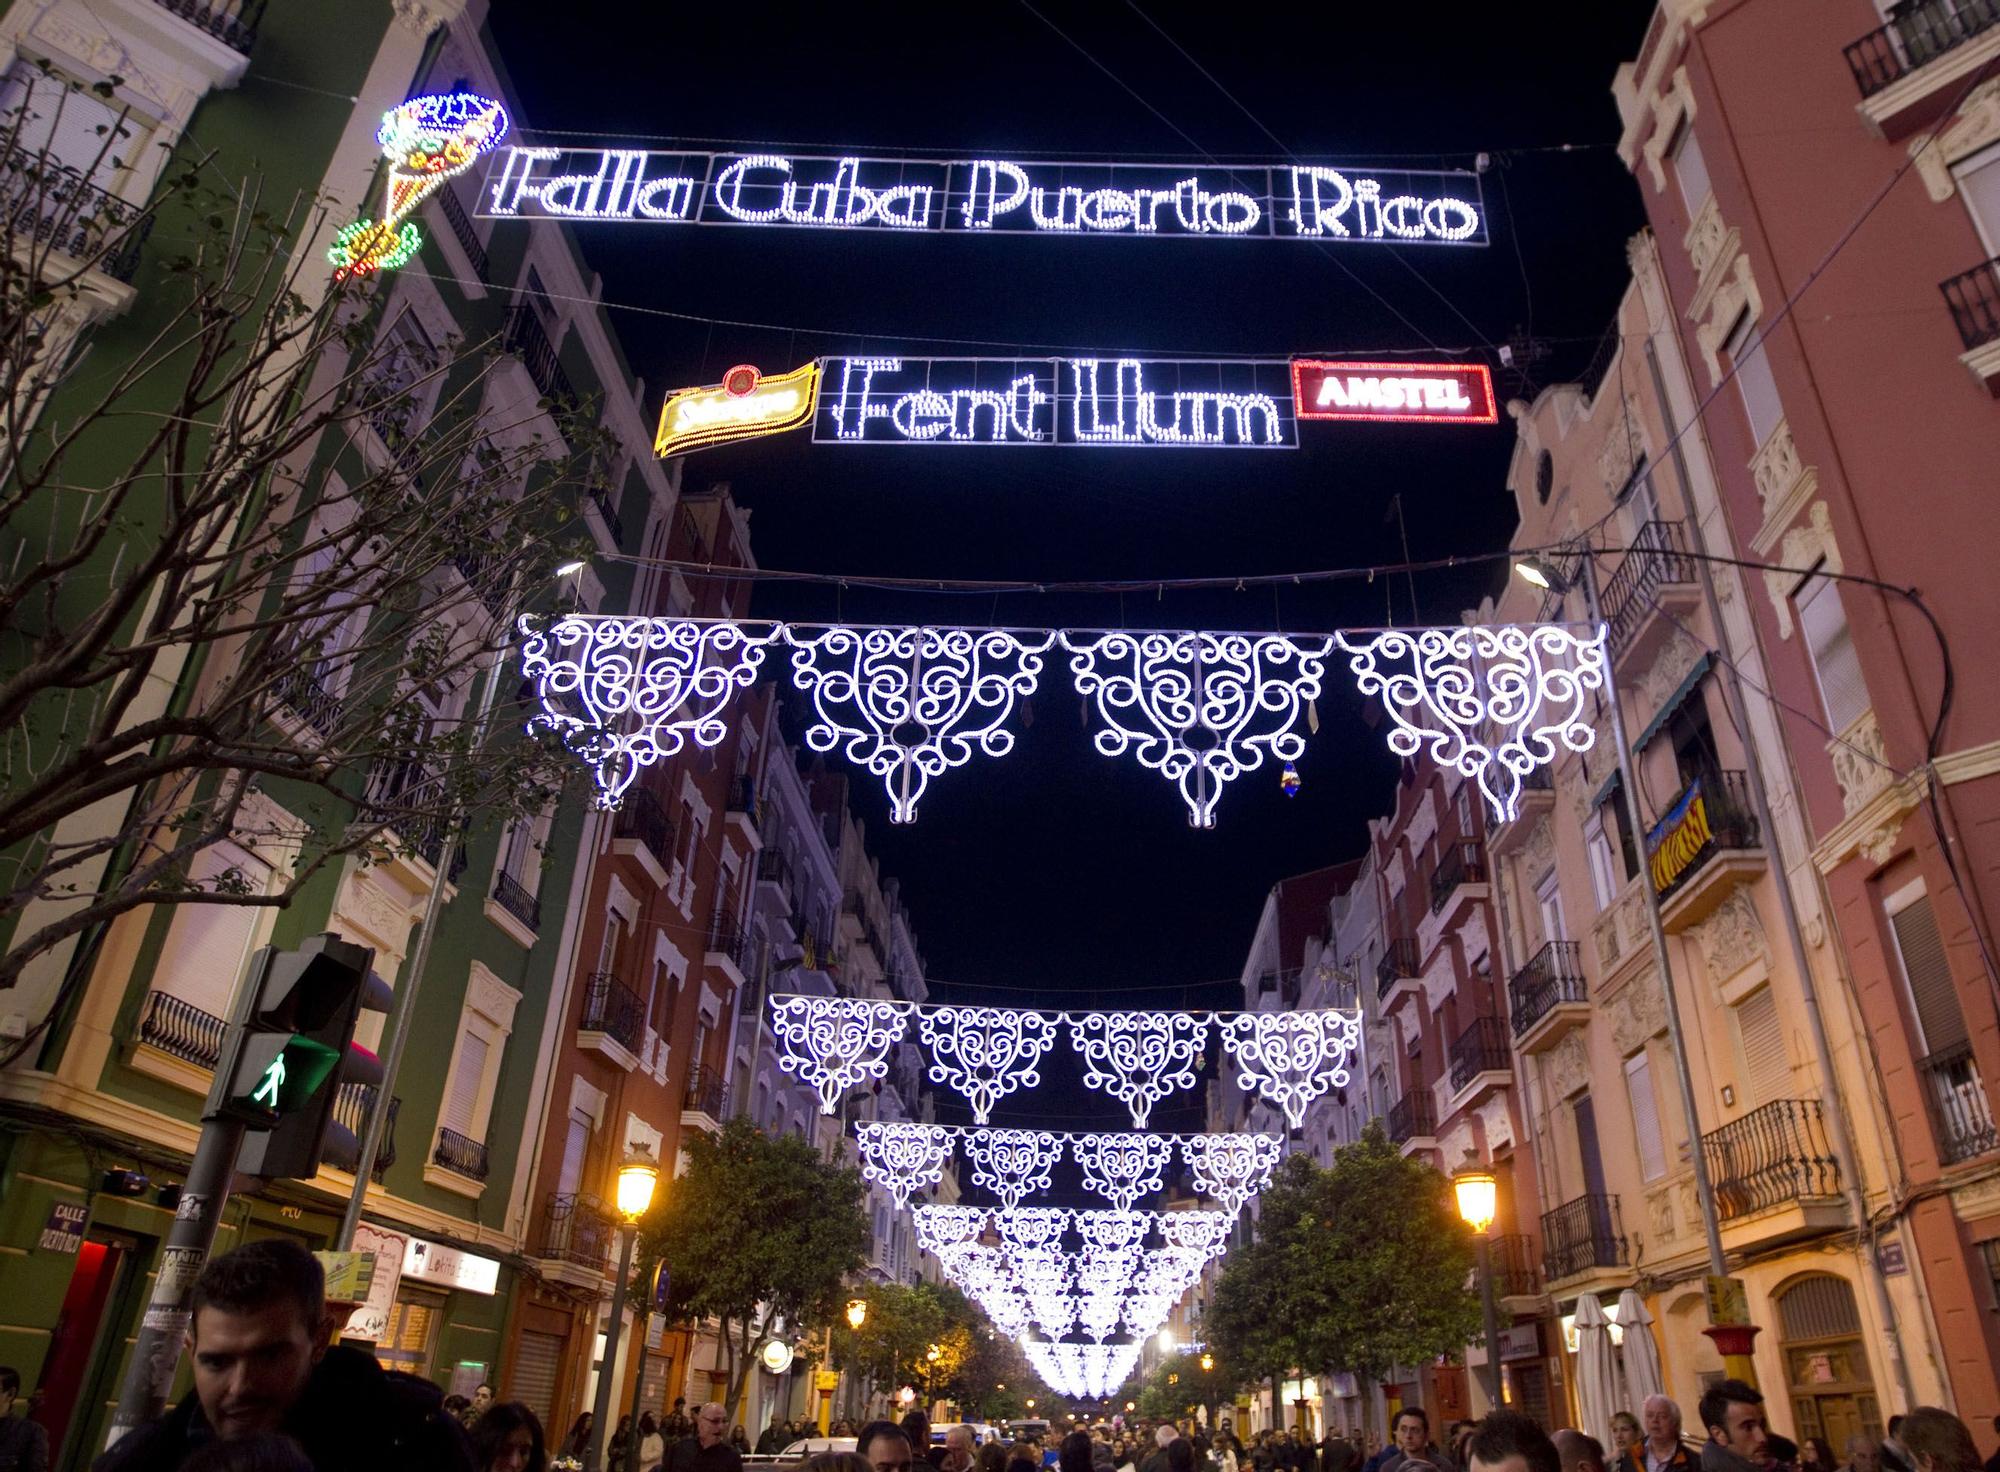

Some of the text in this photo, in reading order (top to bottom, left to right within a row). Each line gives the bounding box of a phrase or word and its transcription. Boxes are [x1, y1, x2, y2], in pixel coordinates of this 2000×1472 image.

[491, 147, 1479, 239] Falla Cuba Puerto Rico
[832, 358, 1046, 440] Fent
[1072, 358, 1284, 442] Llum
[1316, 376, 1471, 409] AMSTEL
[54, 1204, 87, 1223] CALLE
